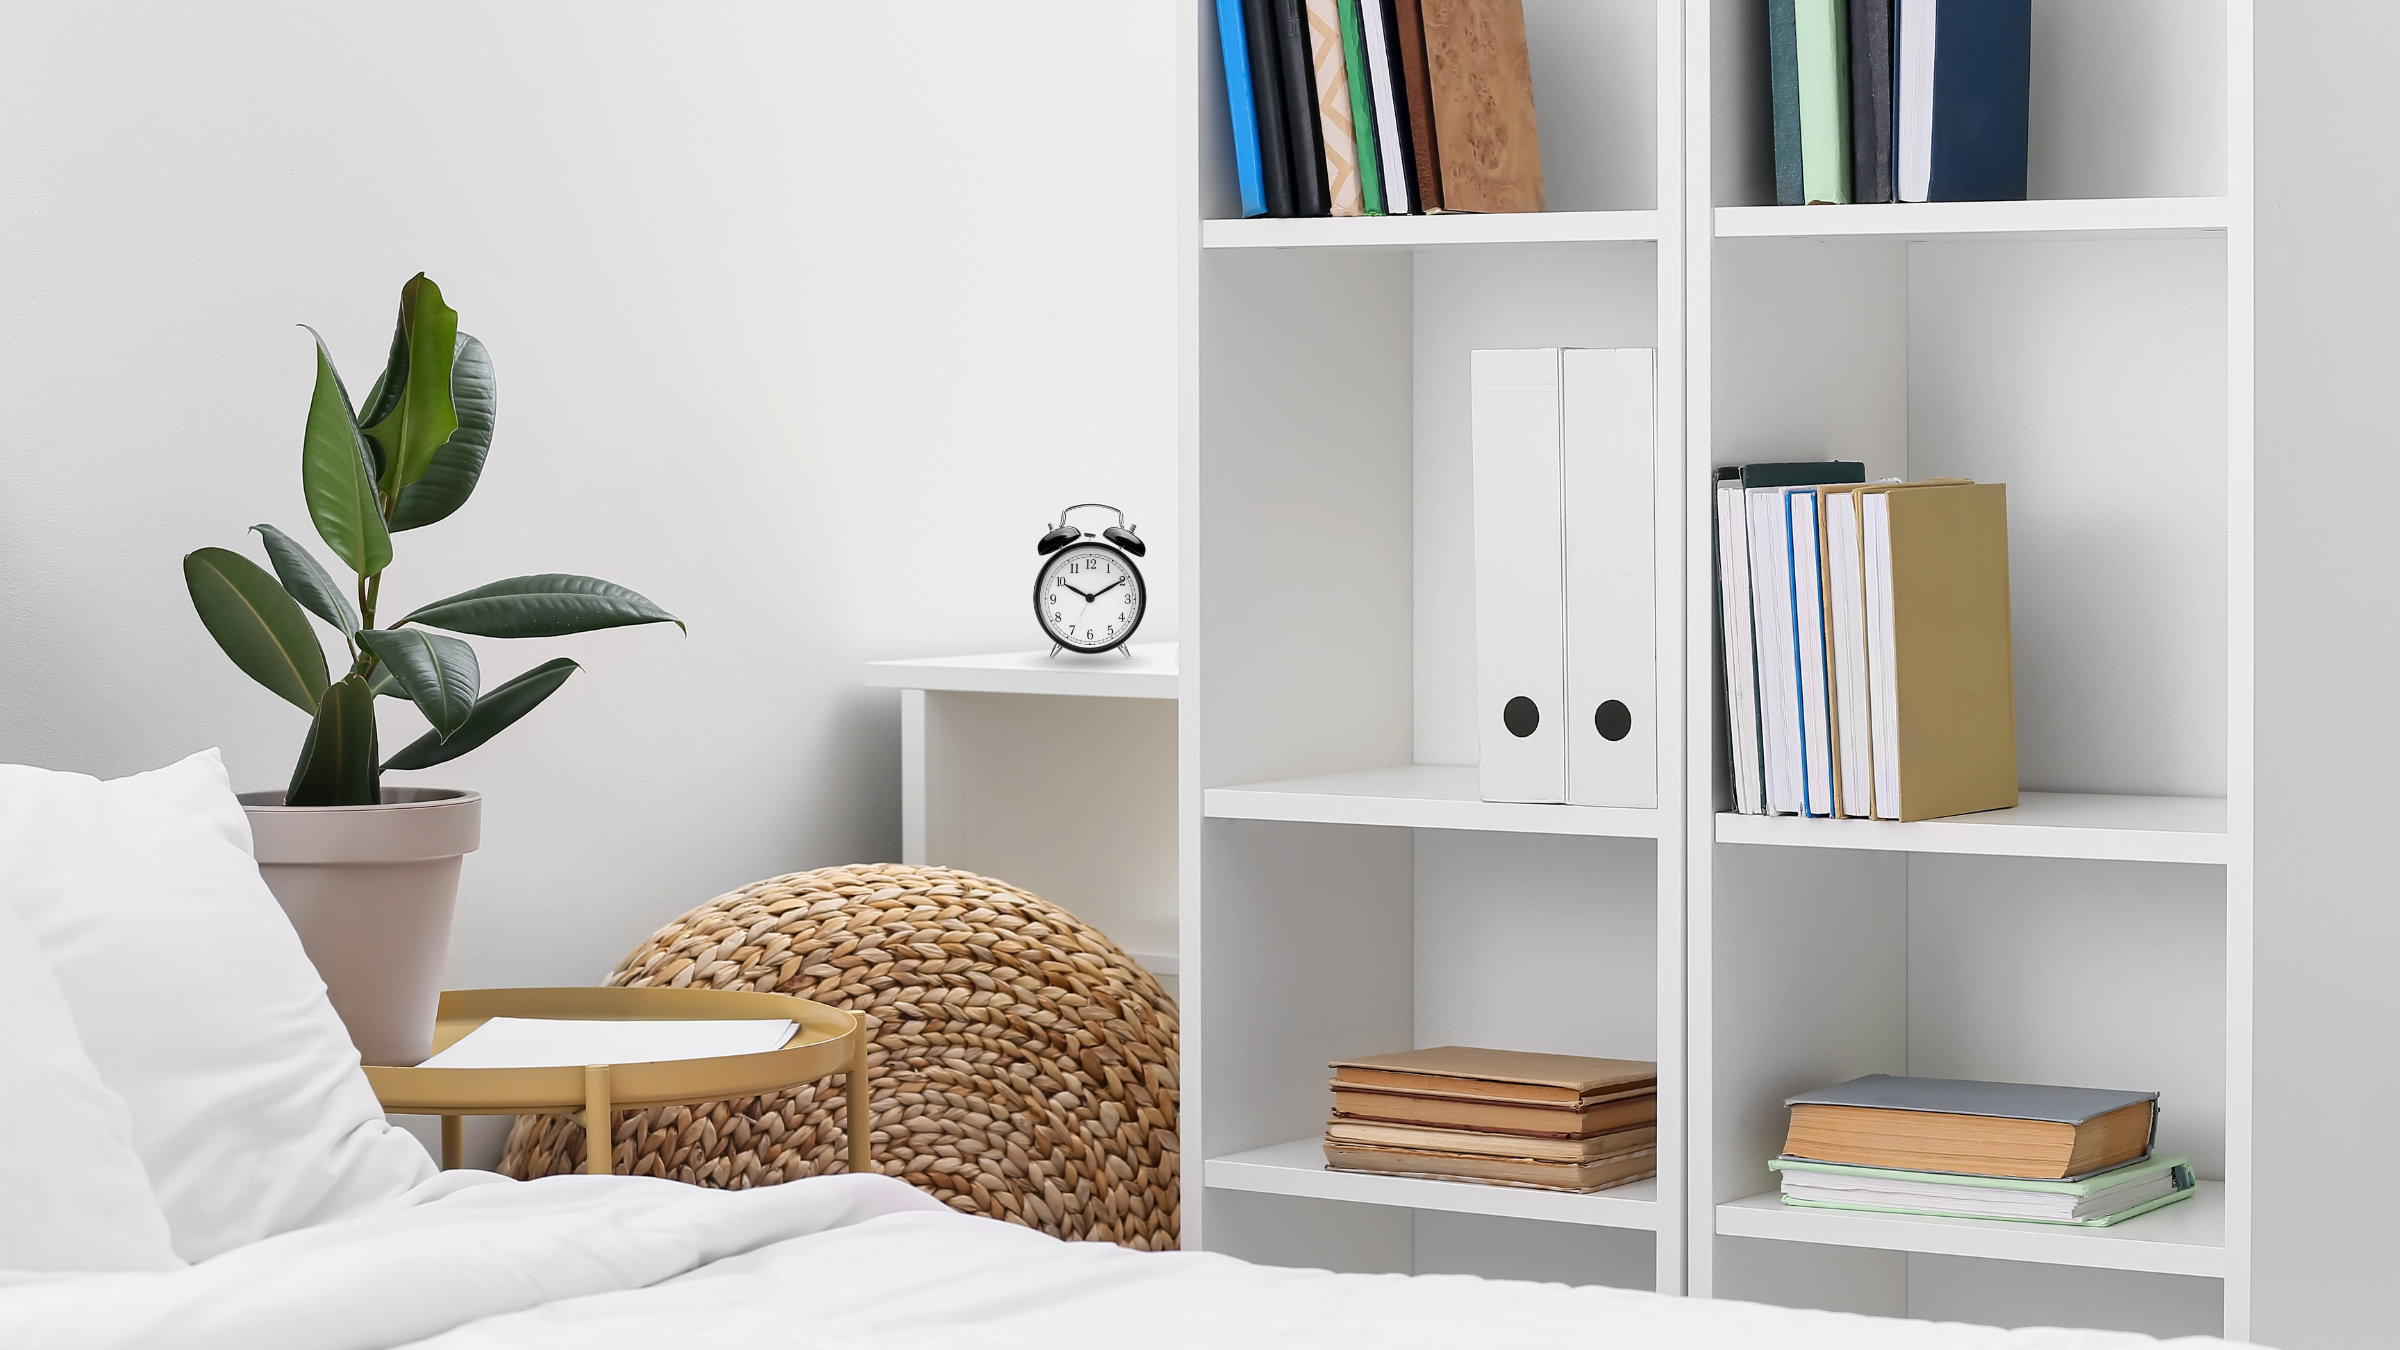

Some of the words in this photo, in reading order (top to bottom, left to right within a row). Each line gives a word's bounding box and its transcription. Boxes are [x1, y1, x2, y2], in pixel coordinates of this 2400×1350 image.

[1070, 563, 1079, 574] 11
[1085, 559, 1096, 569] 12
[1056, 576, 1066, 587] 10
[1119, 575, 1126, 586] 2
[1049, 594, 1057, 604] 9
[1124, 594, 1131, 604] 3
[1054, 612, 1062, 622] 8
[1118, 613, 1125, 622] 4
[1068, 625, 1076, 635] 7
[1086, 629, 1094, 640] 6
[1107, 624, 1114, 635] 5
